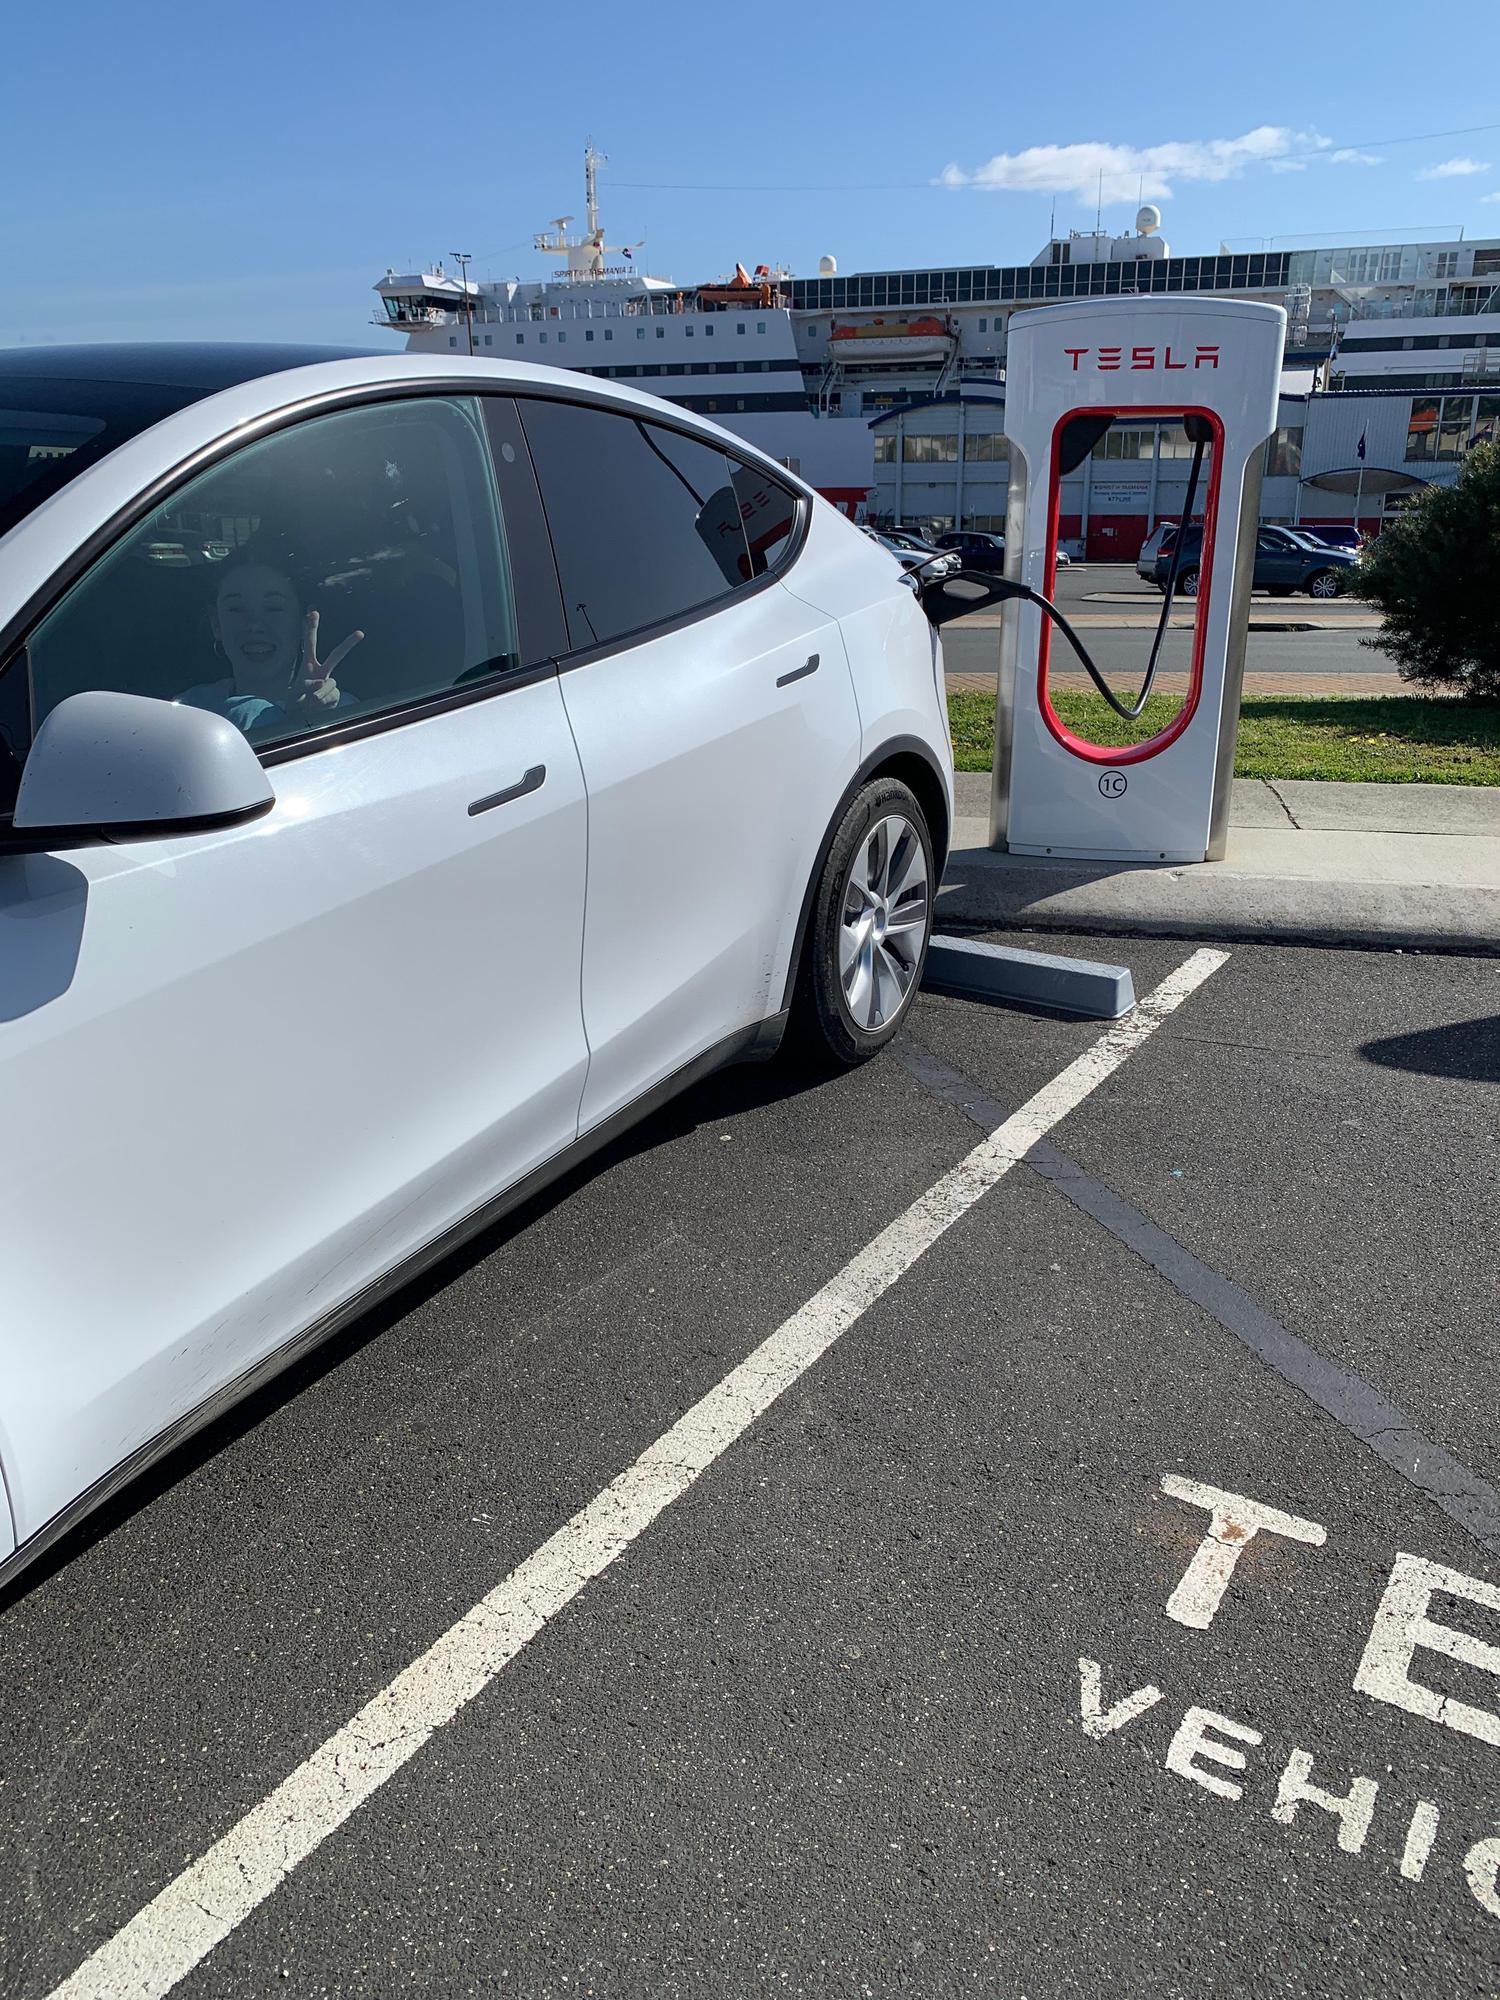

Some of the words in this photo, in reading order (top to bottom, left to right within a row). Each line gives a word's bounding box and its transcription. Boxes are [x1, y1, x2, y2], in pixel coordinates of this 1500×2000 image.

[554, 269, 577, 278] SPIRIT
[589, 266, 626, 277] TASMANIA
[1063, 346, 1220, 371] TESLA
[1104, 778, 1124, 792] 1C
